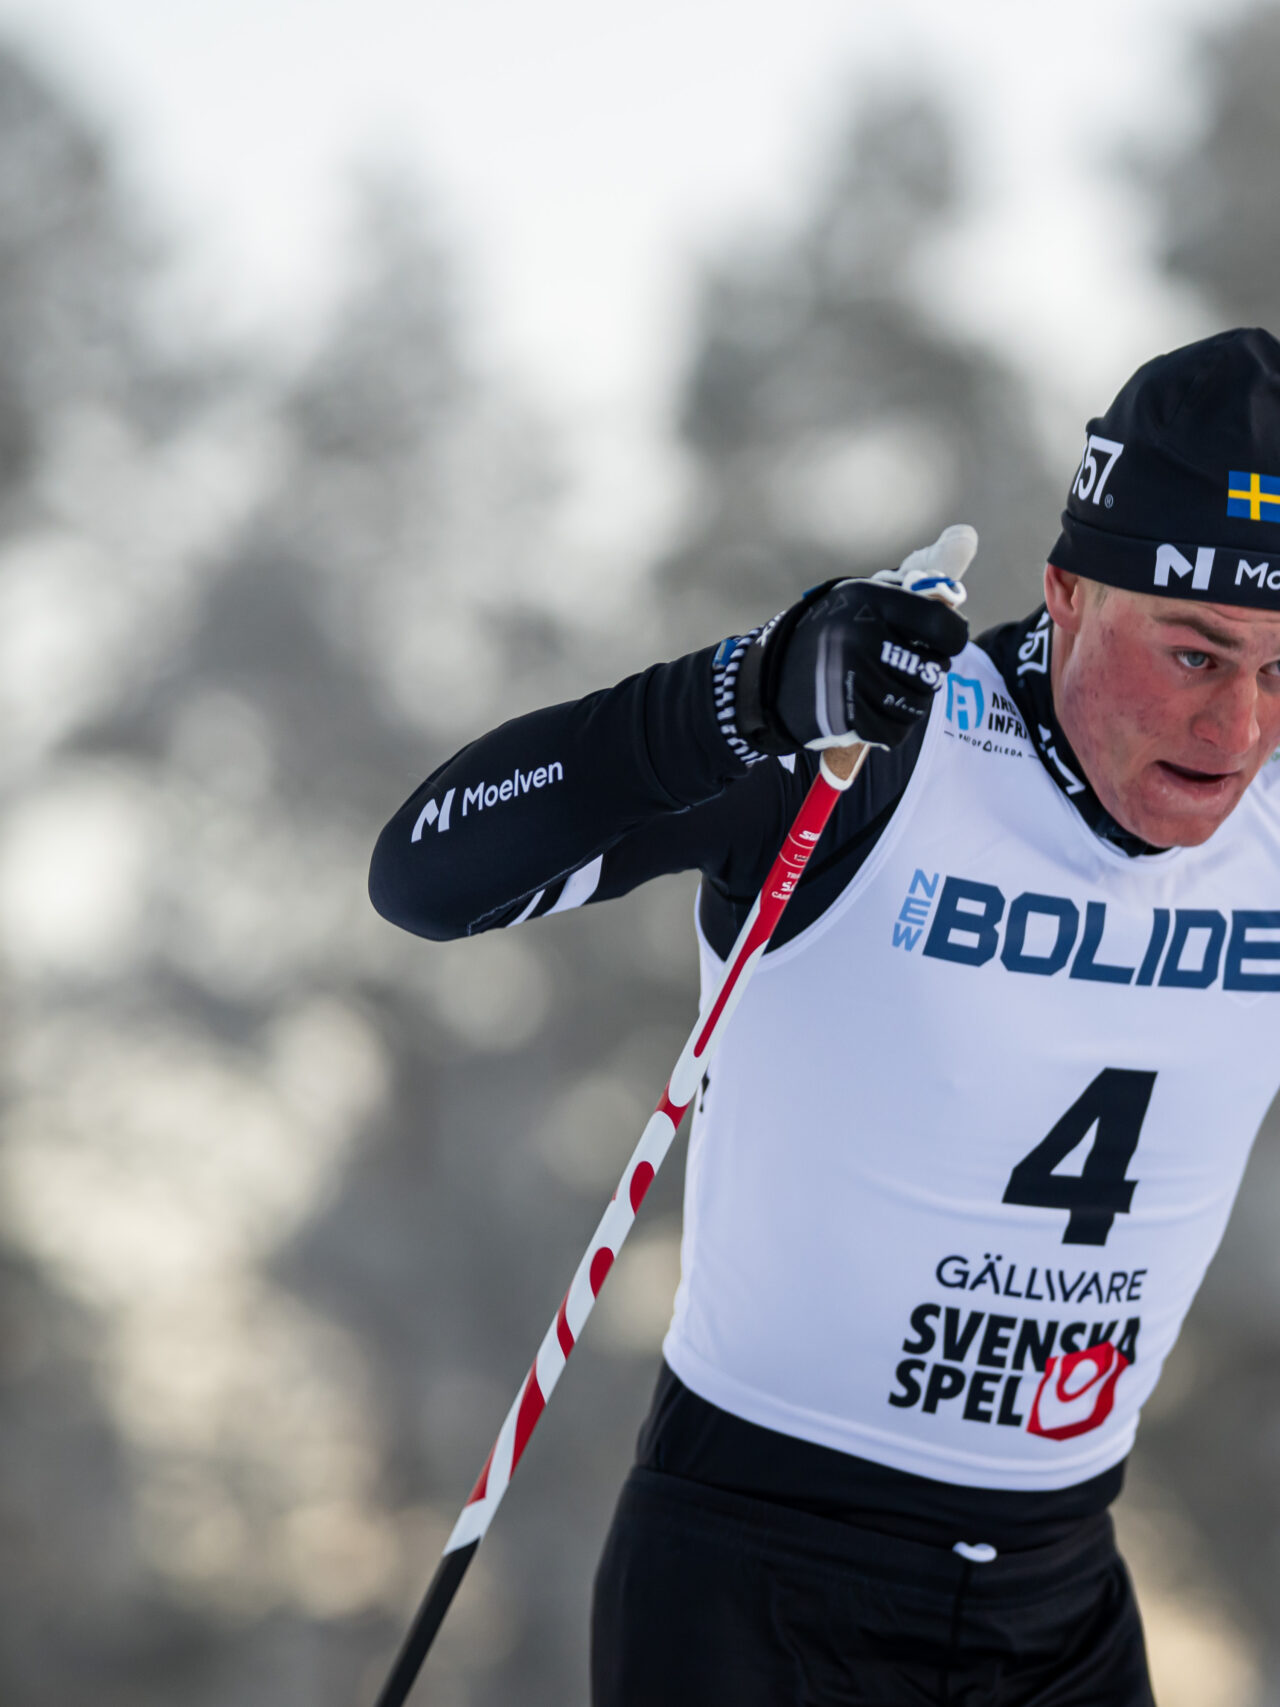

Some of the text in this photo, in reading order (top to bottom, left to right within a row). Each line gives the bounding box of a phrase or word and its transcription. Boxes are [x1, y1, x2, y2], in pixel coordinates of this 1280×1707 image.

[462, 761, 564, 817] Moelven
[892, 868, 939, 953] NEW
[1001, 1066, 1158, 1246] 4
[935, 1252, 1148, 1305] GÄLLIVARE
[901, 1302, 1141, 1373] SVENSKA
[888, 1359, 1023, 1427] SPEL
